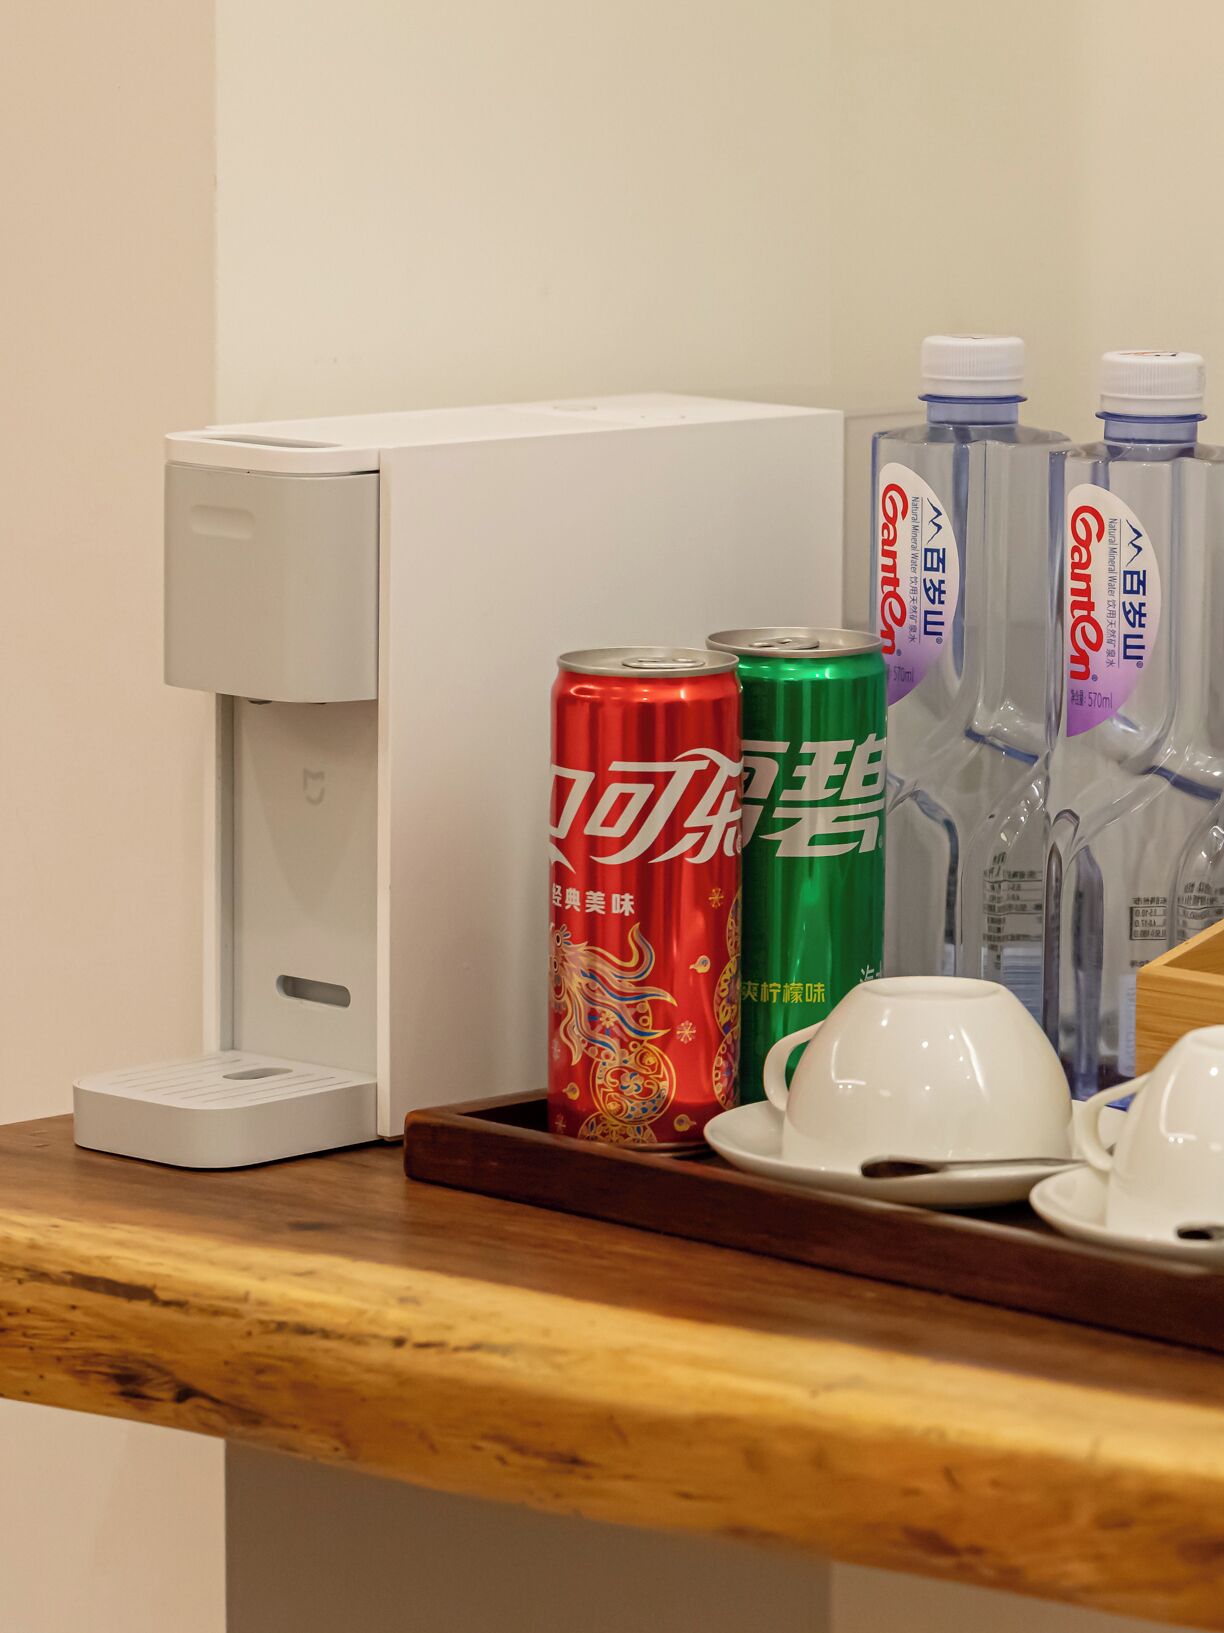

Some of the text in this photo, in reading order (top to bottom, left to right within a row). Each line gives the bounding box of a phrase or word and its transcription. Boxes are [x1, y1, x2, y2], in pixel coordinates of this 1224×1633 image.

[911, 496, 919, 524] Natural
[910, 525, 919, 551] Mineral
[1108, 518, 1117, 546] Natural
[910, 552, 919, 574] Water
[1107, 547, 1118, 575] Mineral
[923, 548, 946, 636] 百岁山
[1107, 575, 1118, 597] Water
[1122, 570, 1147, 660] 百岁山
[1088, 691, 1113, 709] 570ml
[552, 883, 635, 916] 经典美味
